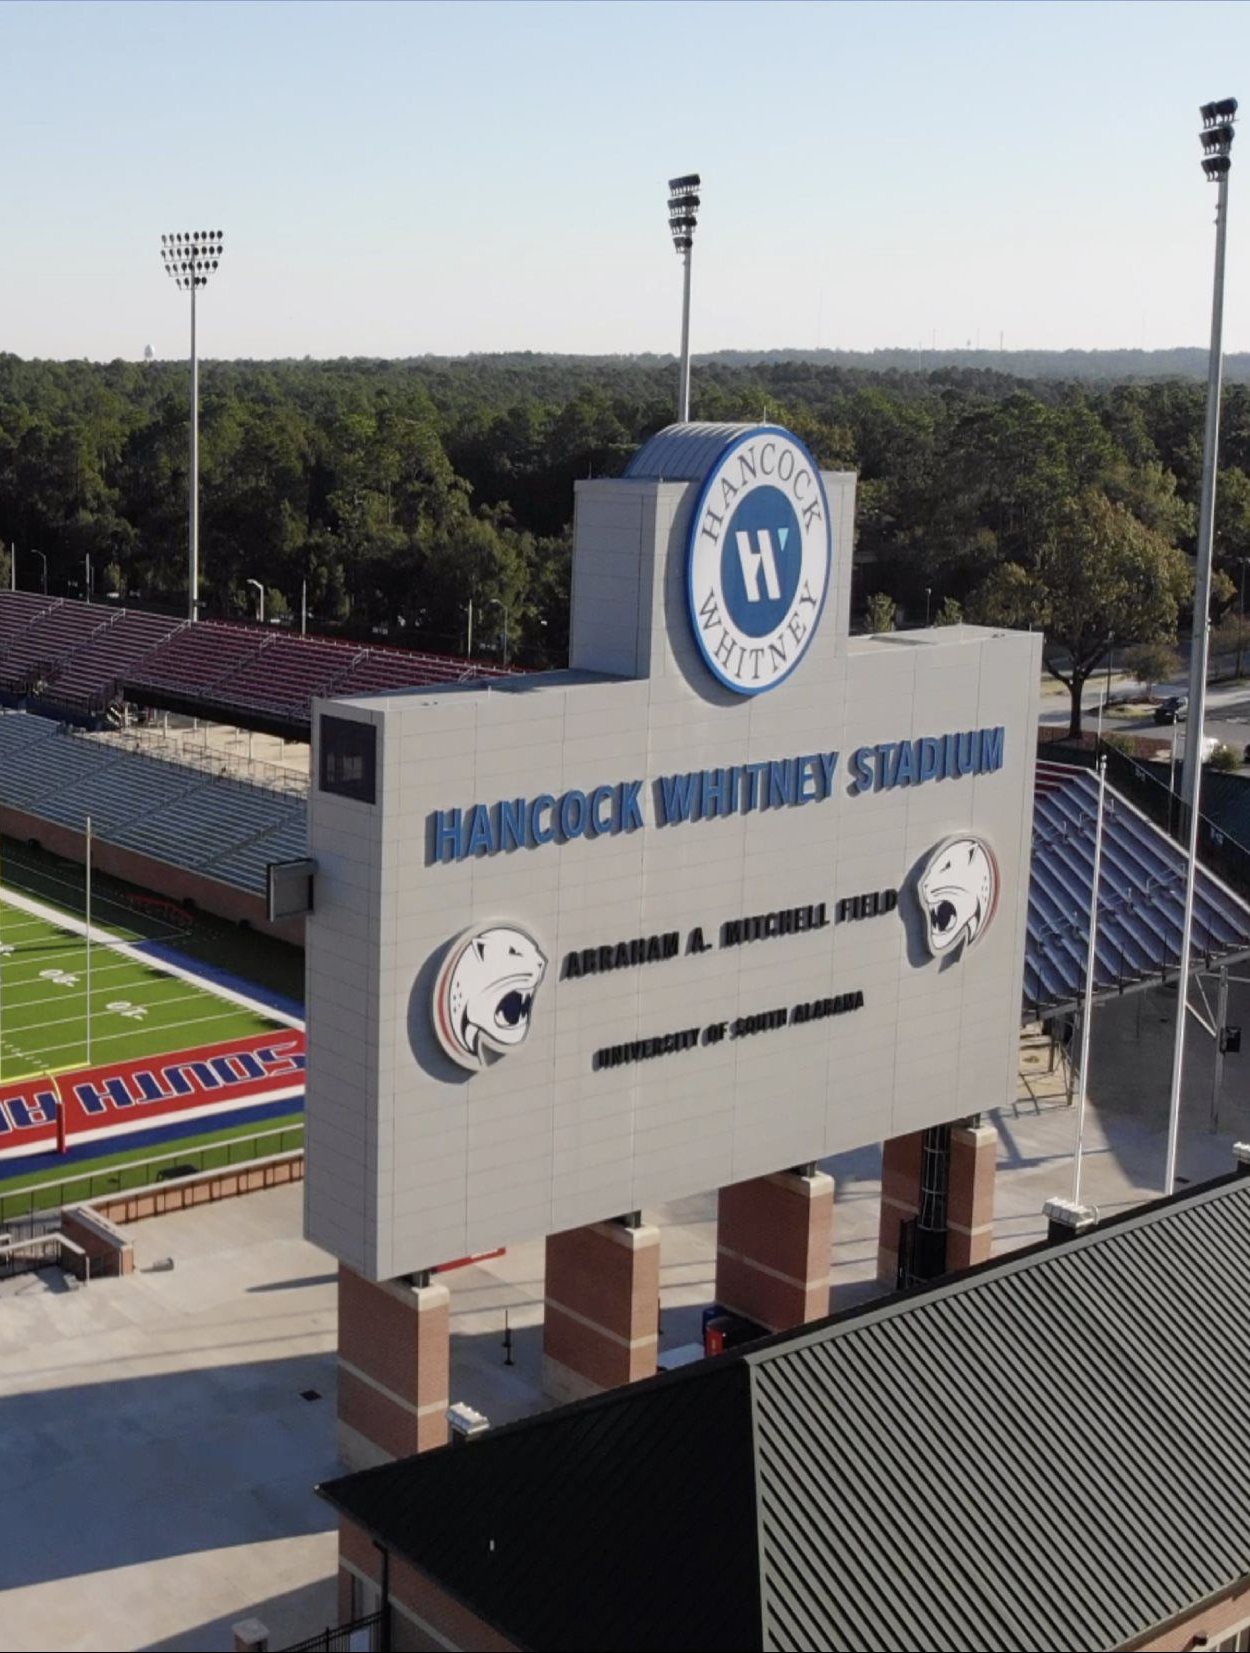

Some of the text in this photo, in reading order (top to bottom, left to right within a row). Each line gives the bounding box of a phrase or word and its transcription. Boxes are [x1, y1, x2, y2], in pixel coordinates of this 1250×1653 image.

[702, 442, 822, 546] HANCOCK
[699, 579, 818, 680] WHITNEY
[431, 726, 1005, 863] HANCOCK WHITNEY STADIUM
[561, 889, 898, 980] ABRAHAM A. MITCHELL FIELD
[73, 1040, 306, 1116] SOUTH
[594, 990, 865, 1071] UNIVERSITY OF SOUTH ALABAMA
